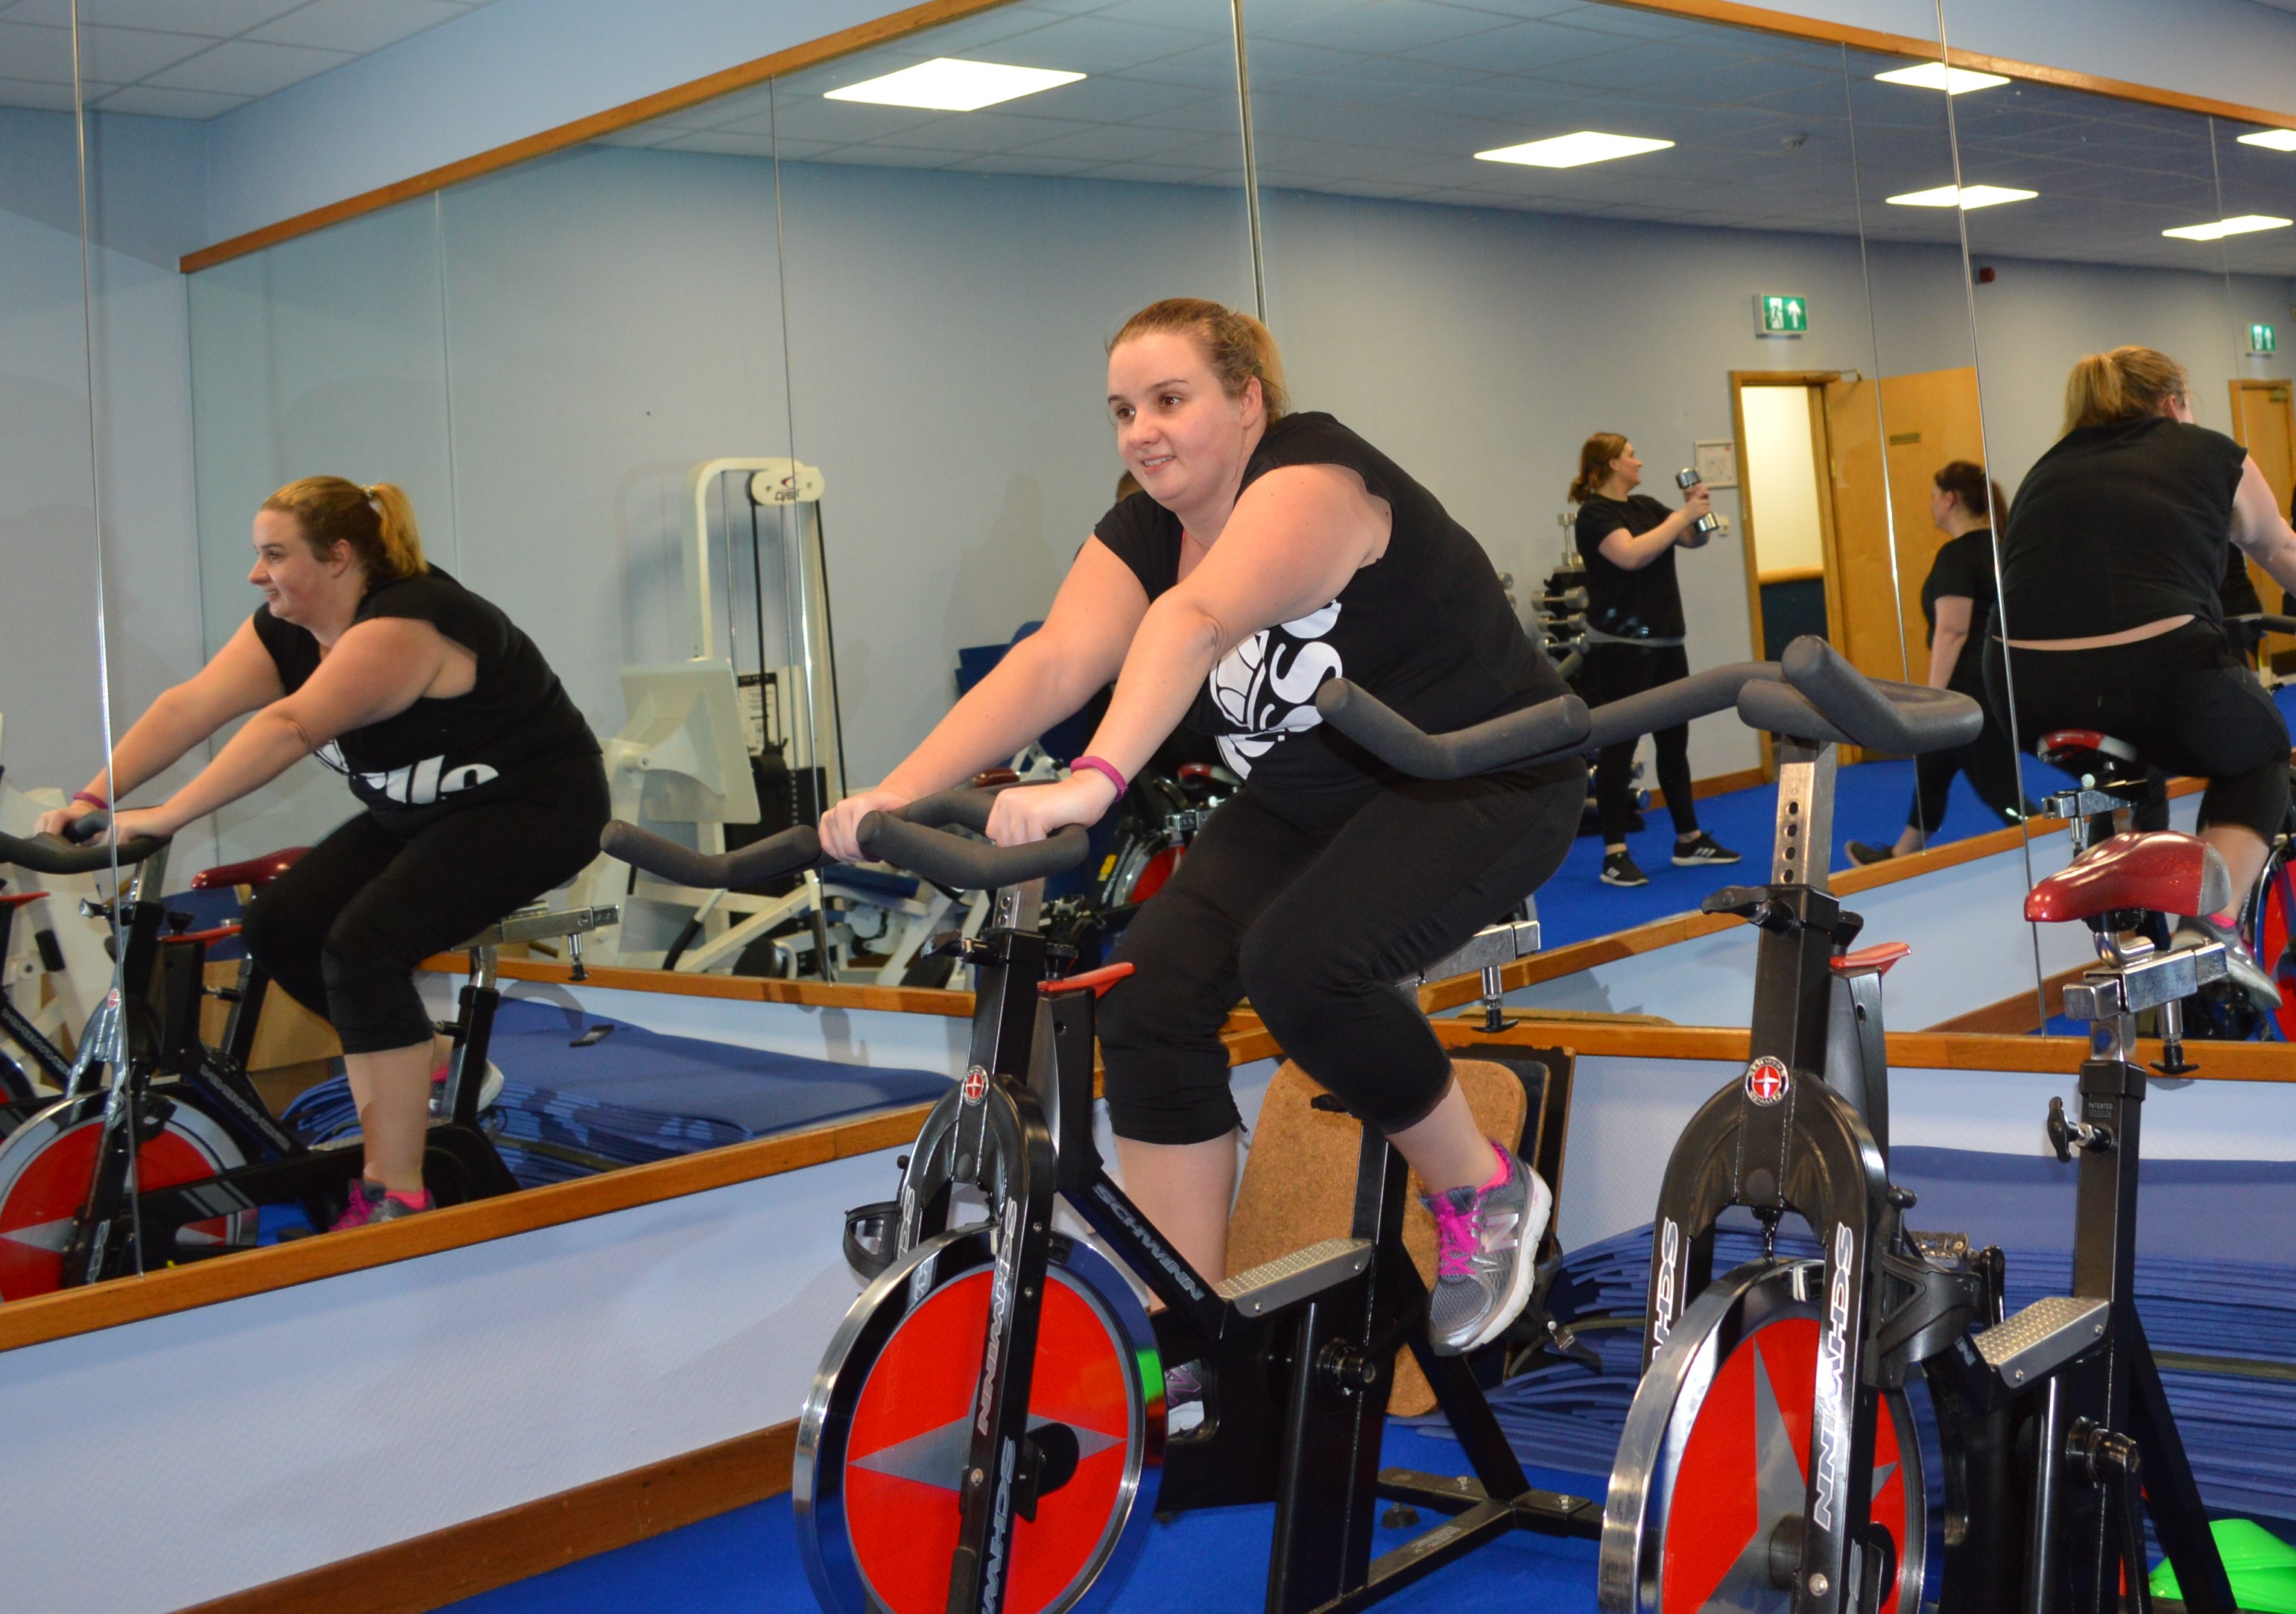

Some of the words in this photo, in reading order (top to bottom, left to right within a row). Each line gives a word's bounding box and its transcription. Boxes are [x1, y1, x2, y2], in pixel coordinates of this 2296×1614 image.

[978, 1196, 1017, 1437] SCHWINN
[1092, 1183, 1205, 1301] SCHWINN
[1813, 1221, 1853, 1532] SCHWINN
[981, 1435, 1016, 1614] SCHW
